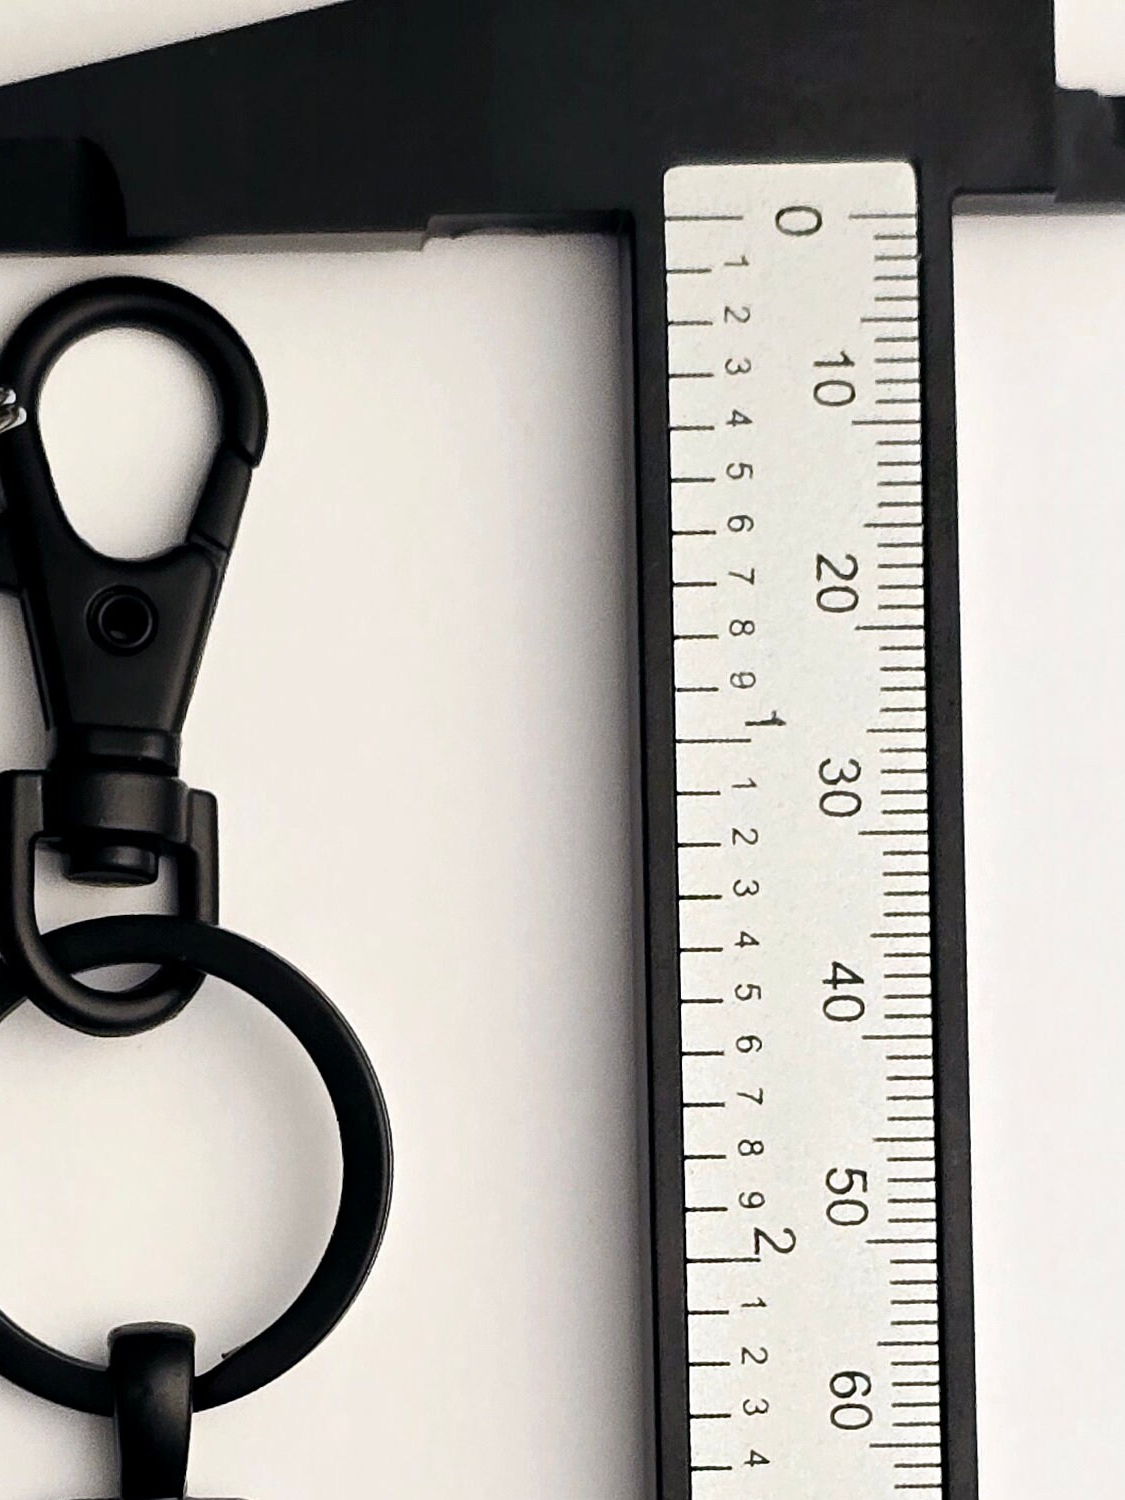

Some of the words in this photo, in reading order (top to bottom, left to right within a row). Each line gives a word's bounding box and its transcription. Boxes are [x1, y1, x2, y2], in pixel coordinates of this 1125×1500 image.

[775, 206, 823, 237] 0
[724, 255, 749, 266] 1
[724, 306, 750, 323] 2
[725, 358, 751, 375] 3
[813, 350, 856, 407] 10
[726, 409, 753, 427] 4
[726, 462, 753, 480] 5
[727, 515, 754, 532] 6
[728, 568, 755, 585] 7
[816, 553, 859, 613] 20
[729, 619, 755, 636] 8
[730, 672, 756, 689] 9
[745, 710, 786, 726] 1
[731, 778, 757, 788] 1
[818, 758, 862, 817] 30
[732, 828, 758, 845] 2
[733, 879, 759, 897] 3
[734, 931, 760, 948] 4
[734, 984, 761, 1001] 5
[822, 961, 865, 1022] 40
[736, 1035, 762, 1053] 6
[737, 1088, 763, 1105] 7
[738, 1139, 764, 1156] 8
[738, 1192, 765, 1209] 9
[825, 1168, 869, 1226] 50
[753, 1227, 796, 1255] 2
[741, 1297, 767, 1307] 1
[741, 1347, 768, 1364] 2
[743, 1399, 769, 1416] 3
[829, 1371, 873, 1430] 60
[744, 1449, 770, 1467] 4
